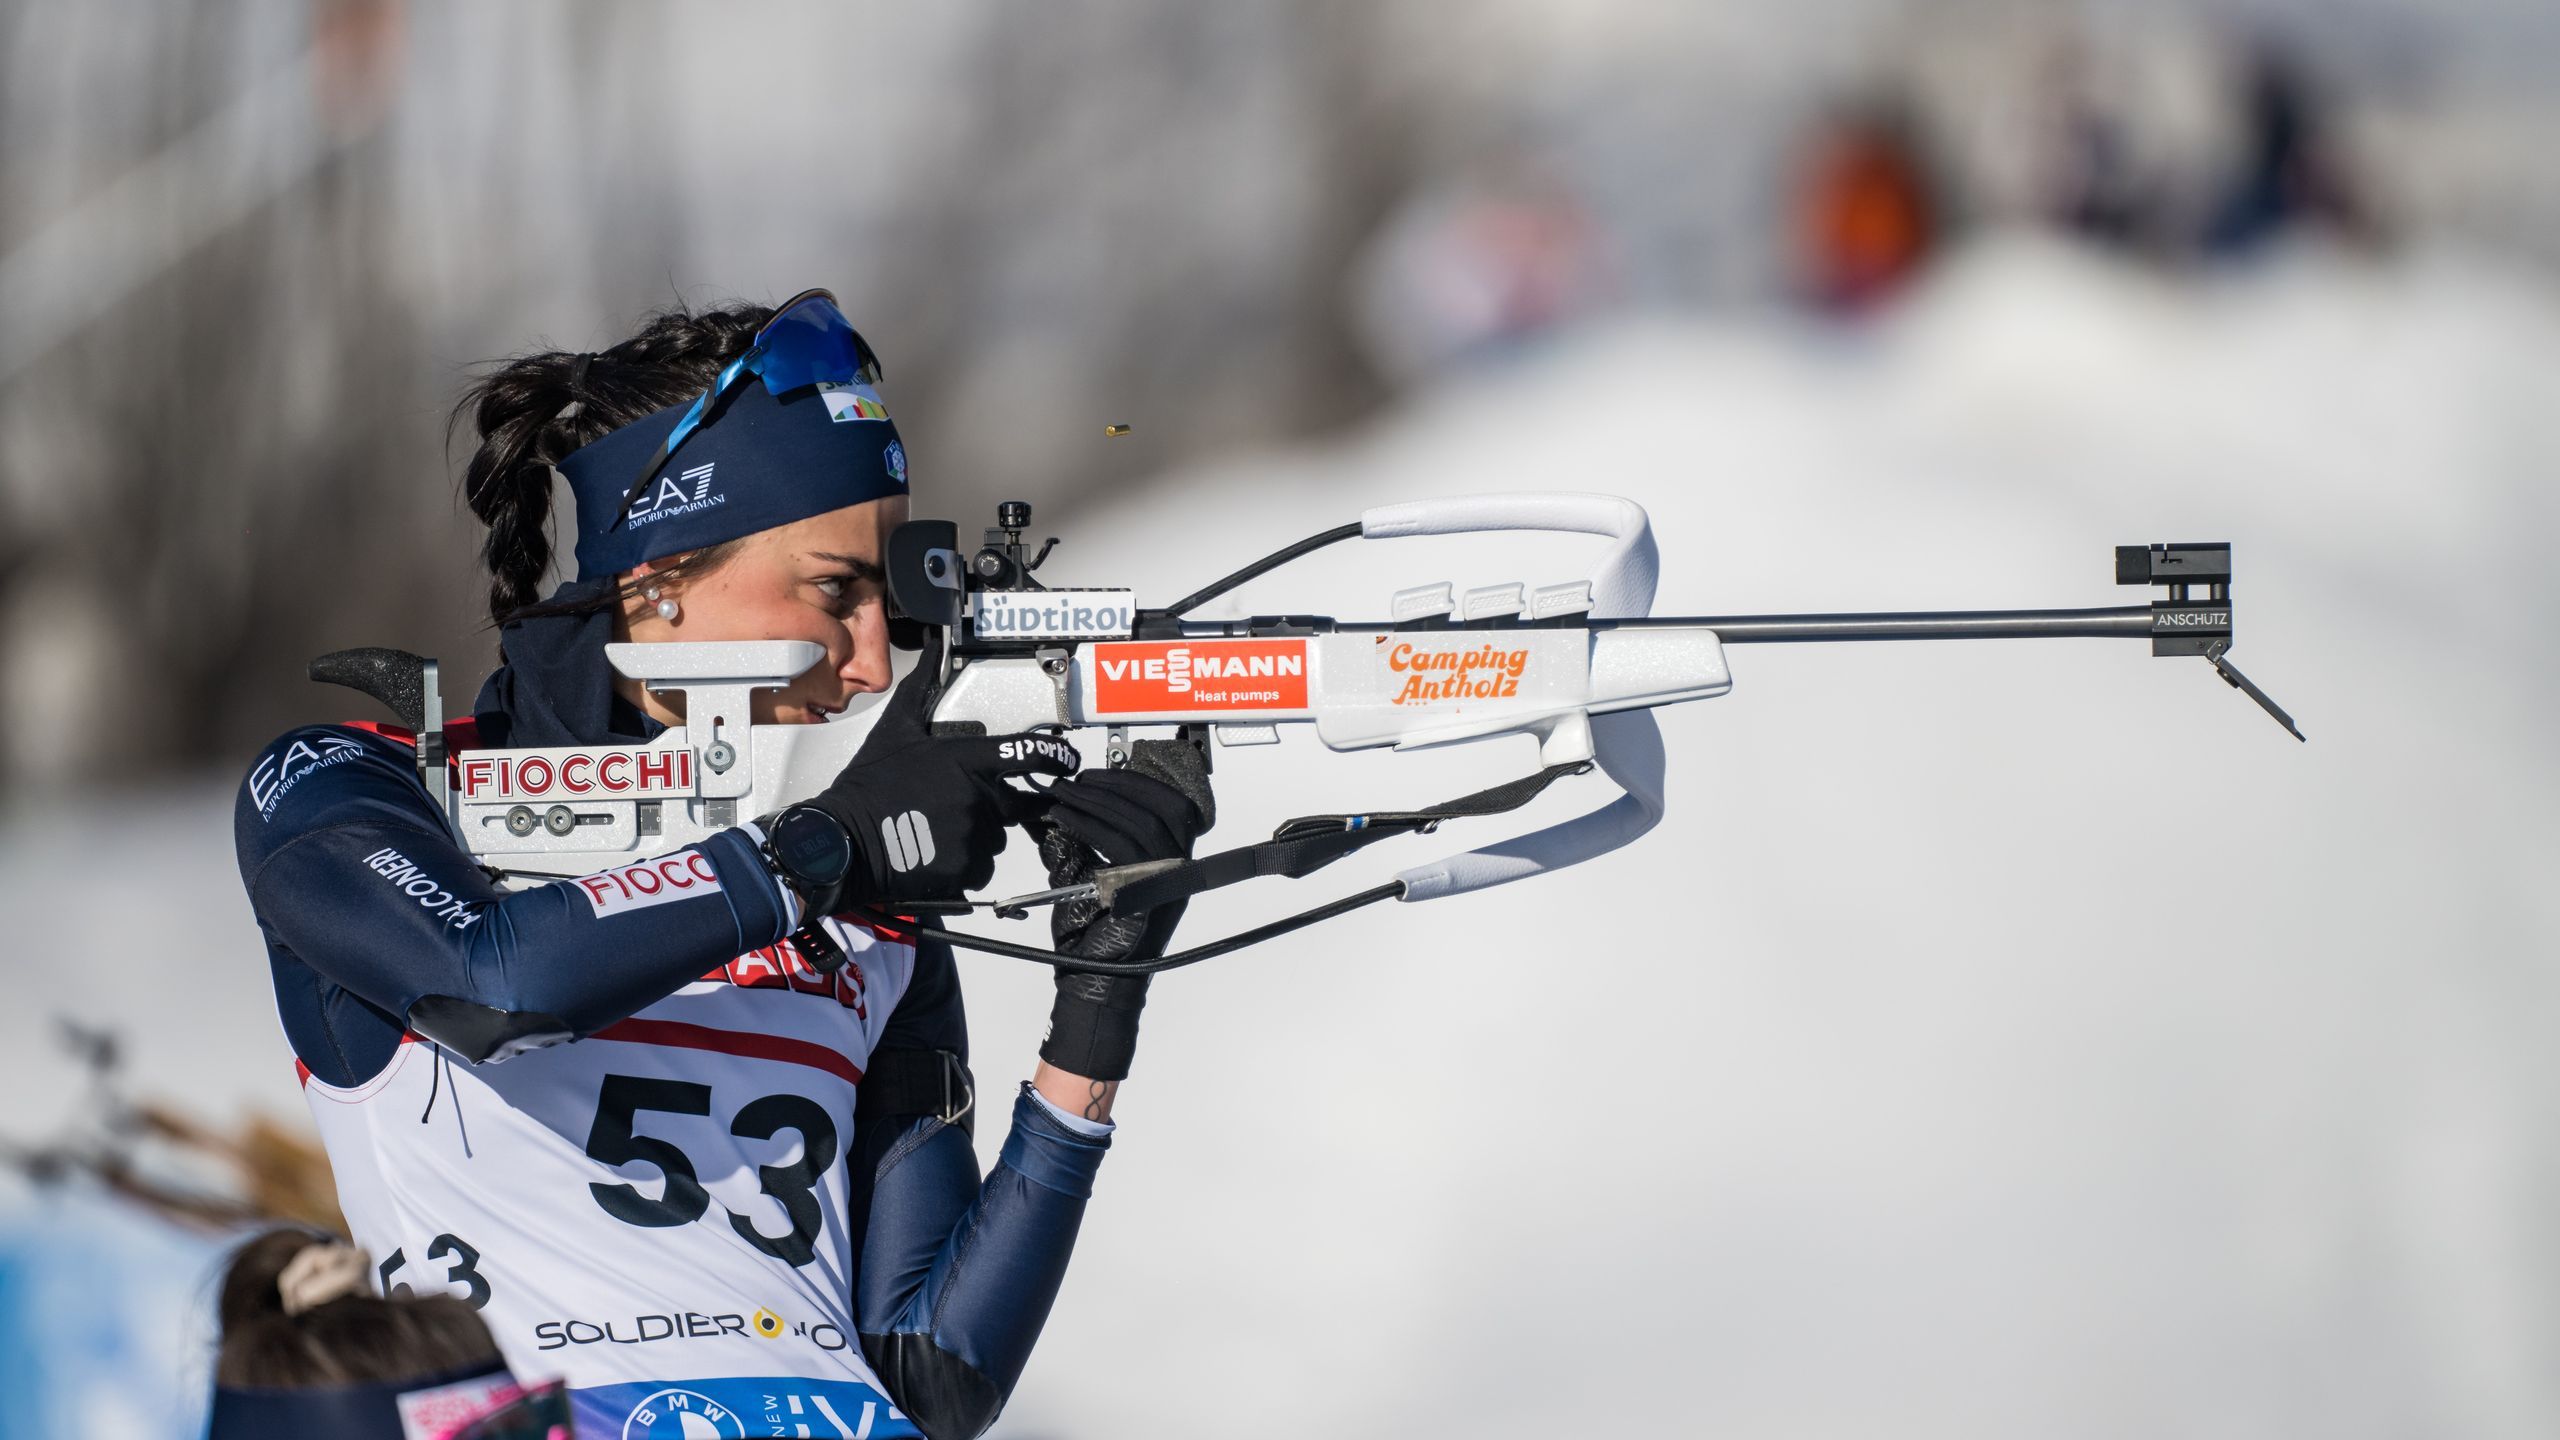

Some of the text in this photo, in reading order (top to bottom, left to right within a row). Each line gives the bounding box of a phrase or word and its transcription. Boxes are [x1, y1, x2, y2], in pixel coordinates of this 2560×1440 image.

[628, 493, 726, 531] EMPORIO ARMANI
[2157, 613, 2228, 626] ANSCHÜTZ
[1100, 648, 1302, 693] VIESSMANN
[1389, 643, 1529, 678] Camping
[1194, 689, 1280, 704] Heat pumps
[1391, 673, 1520, 705] Antholz
[262, 746, 364, 823] EMPORIO ARMANI
[462, 749, 694, 799] FIOCCHI
[585, 1073, 838, 1269] 53
[534, 1311, 752, 1351] SOLDIER
[635, 1393, 726, 1428] BMW
[762, 1393, 786, 1438] NEW
